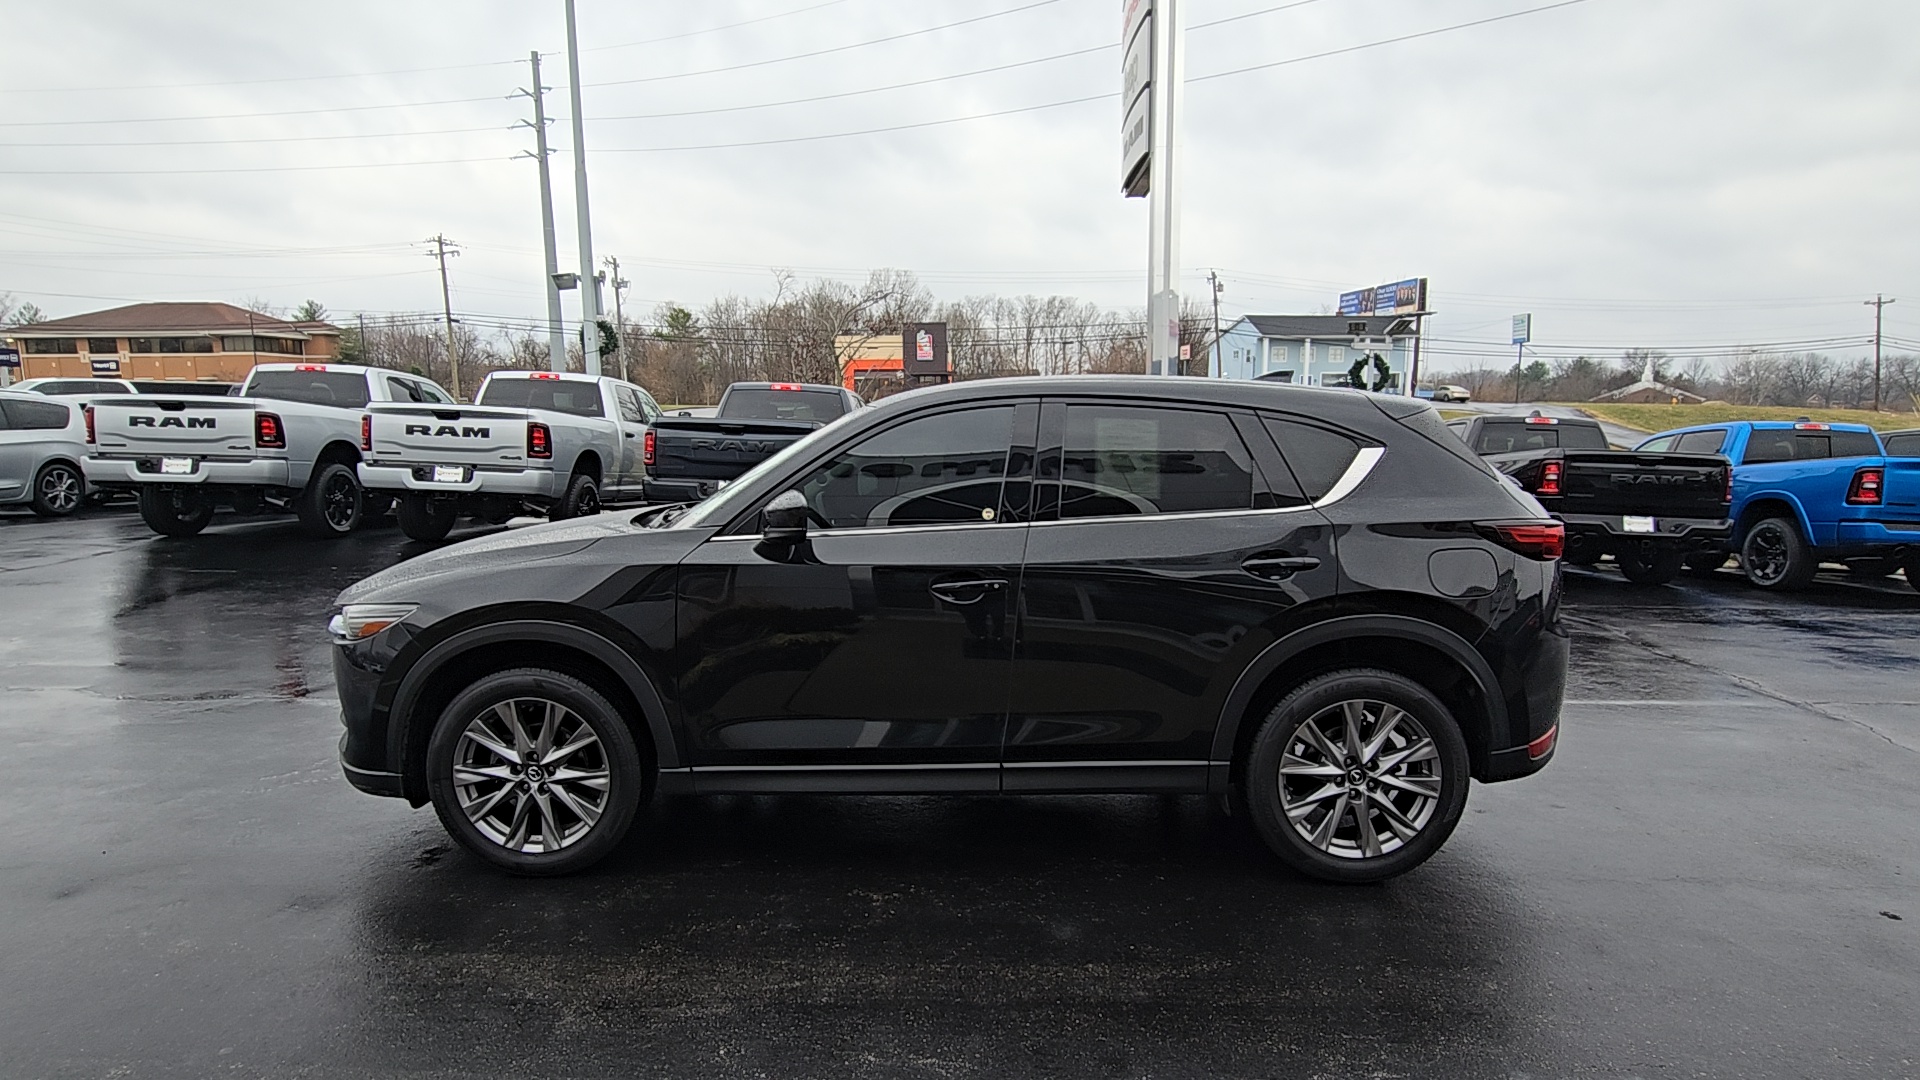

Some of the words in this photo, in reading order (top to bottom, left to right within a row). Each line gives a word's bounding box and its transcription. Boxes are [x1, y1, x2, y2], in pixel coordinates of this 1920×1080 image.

[129, 416, 216, 429] RAM
[405, 424, 491, 439] RAM
[691, 439, 775, 453] RAM
[1610, 473, 1685, 485] RAM
